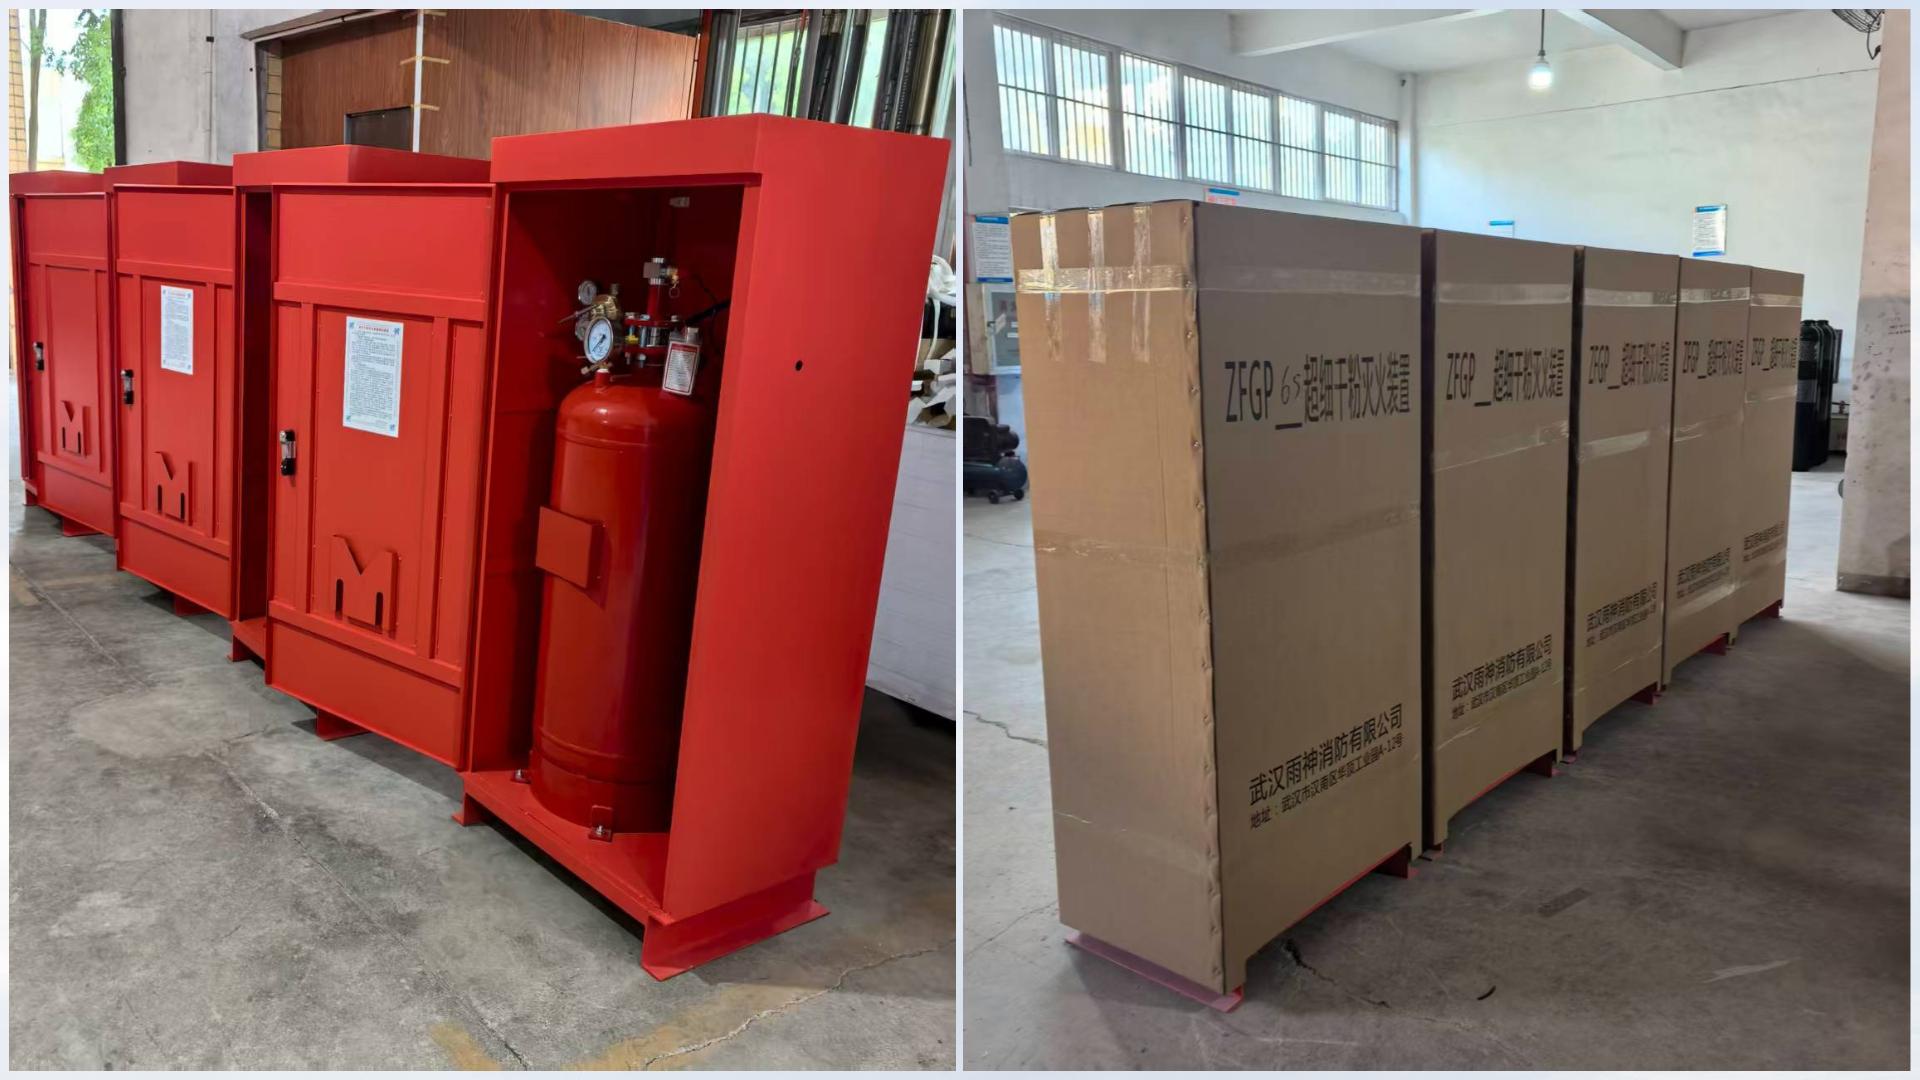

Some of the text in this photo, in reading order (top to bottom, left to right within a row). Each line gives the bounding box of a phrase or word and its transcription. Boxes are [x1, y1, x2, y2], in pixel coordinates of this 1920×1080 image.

[1249, 702, 1403, 806] 武汉雨神消防有限公司
